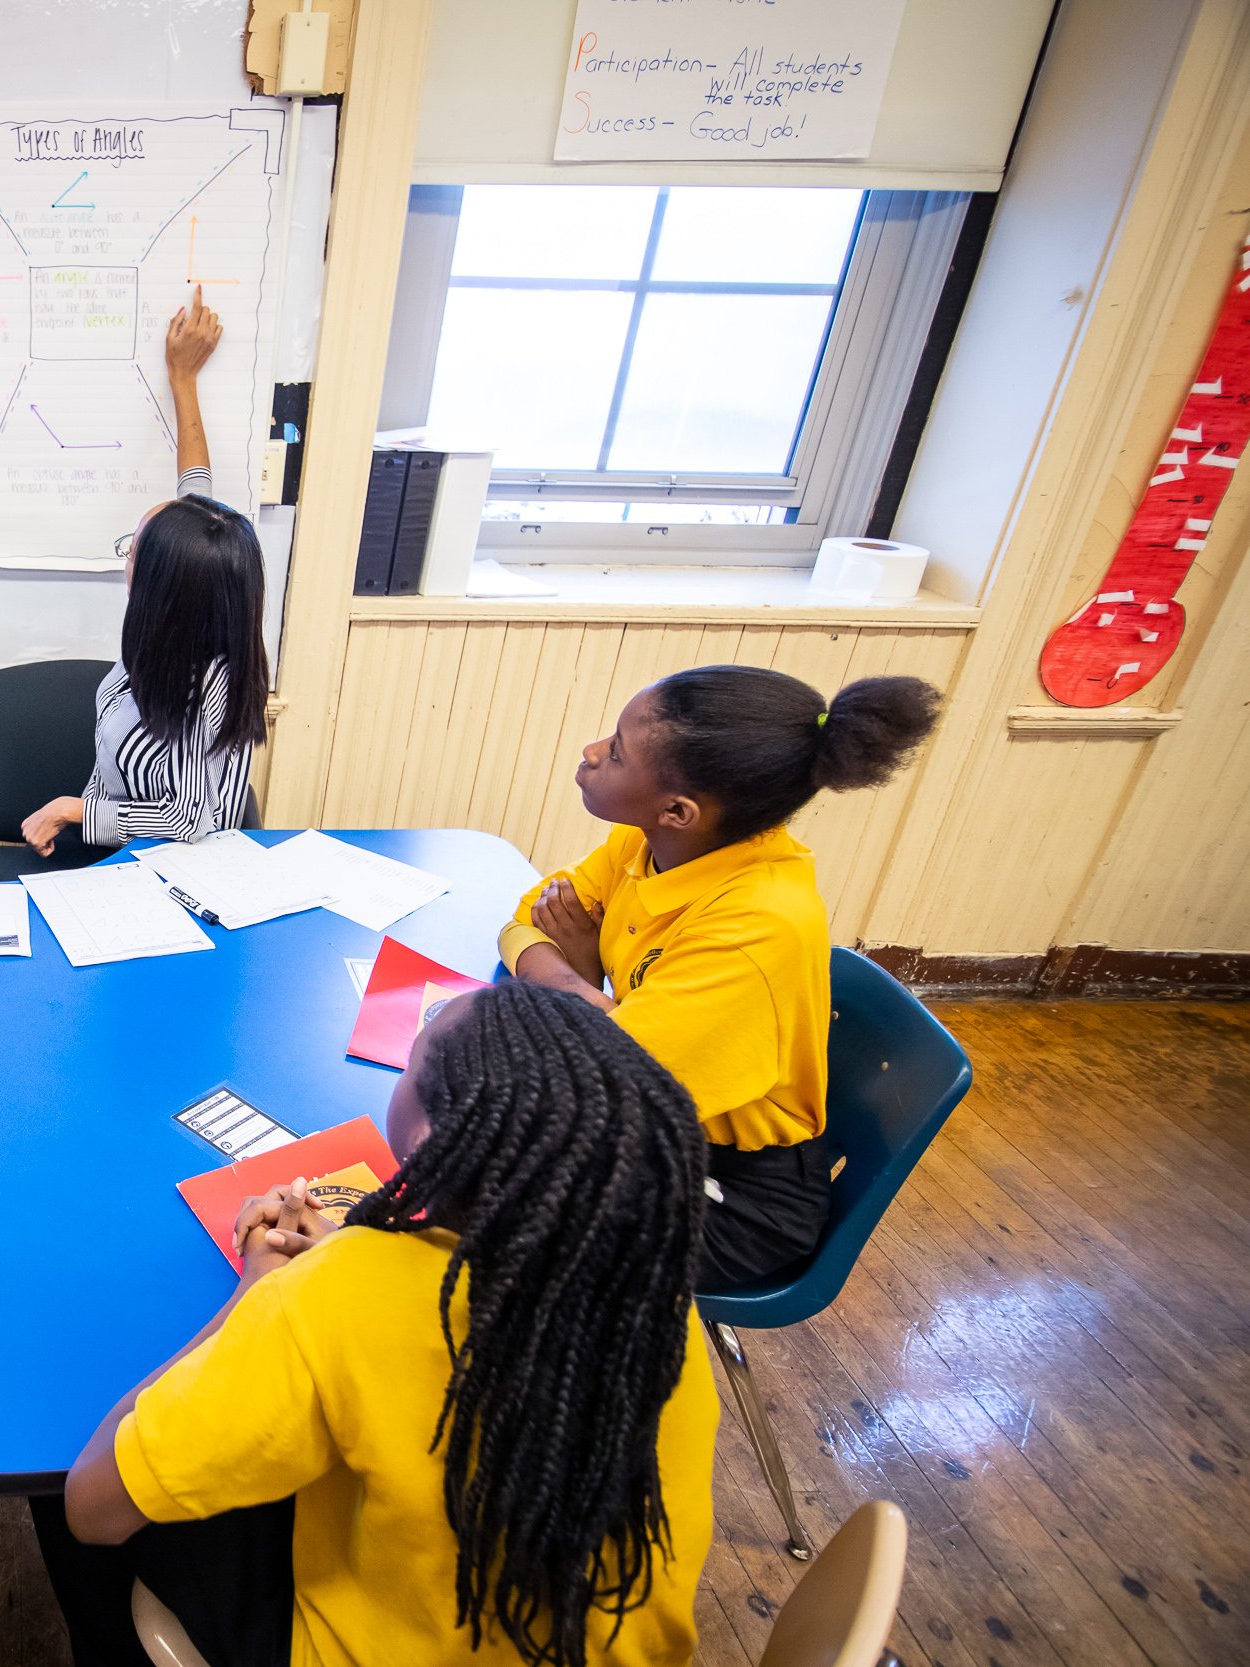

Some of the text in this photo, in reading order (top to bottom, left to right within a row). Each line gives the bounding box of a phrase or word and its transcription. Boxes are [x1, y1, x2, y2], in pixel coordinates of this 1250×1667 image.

[729, 46, 763, 75] All
[772, 53, 862, 76] students
[755, 75, 844, 99] complete
[705, 93, 733, 106] the
[690, 111, 752, 142] Good
[751, 113, 807, 148] job!
[11, 126, 145, 168] Types of Angles
[54, 271, 89, 288] angle
[318, 1186, 337, 1195] The
